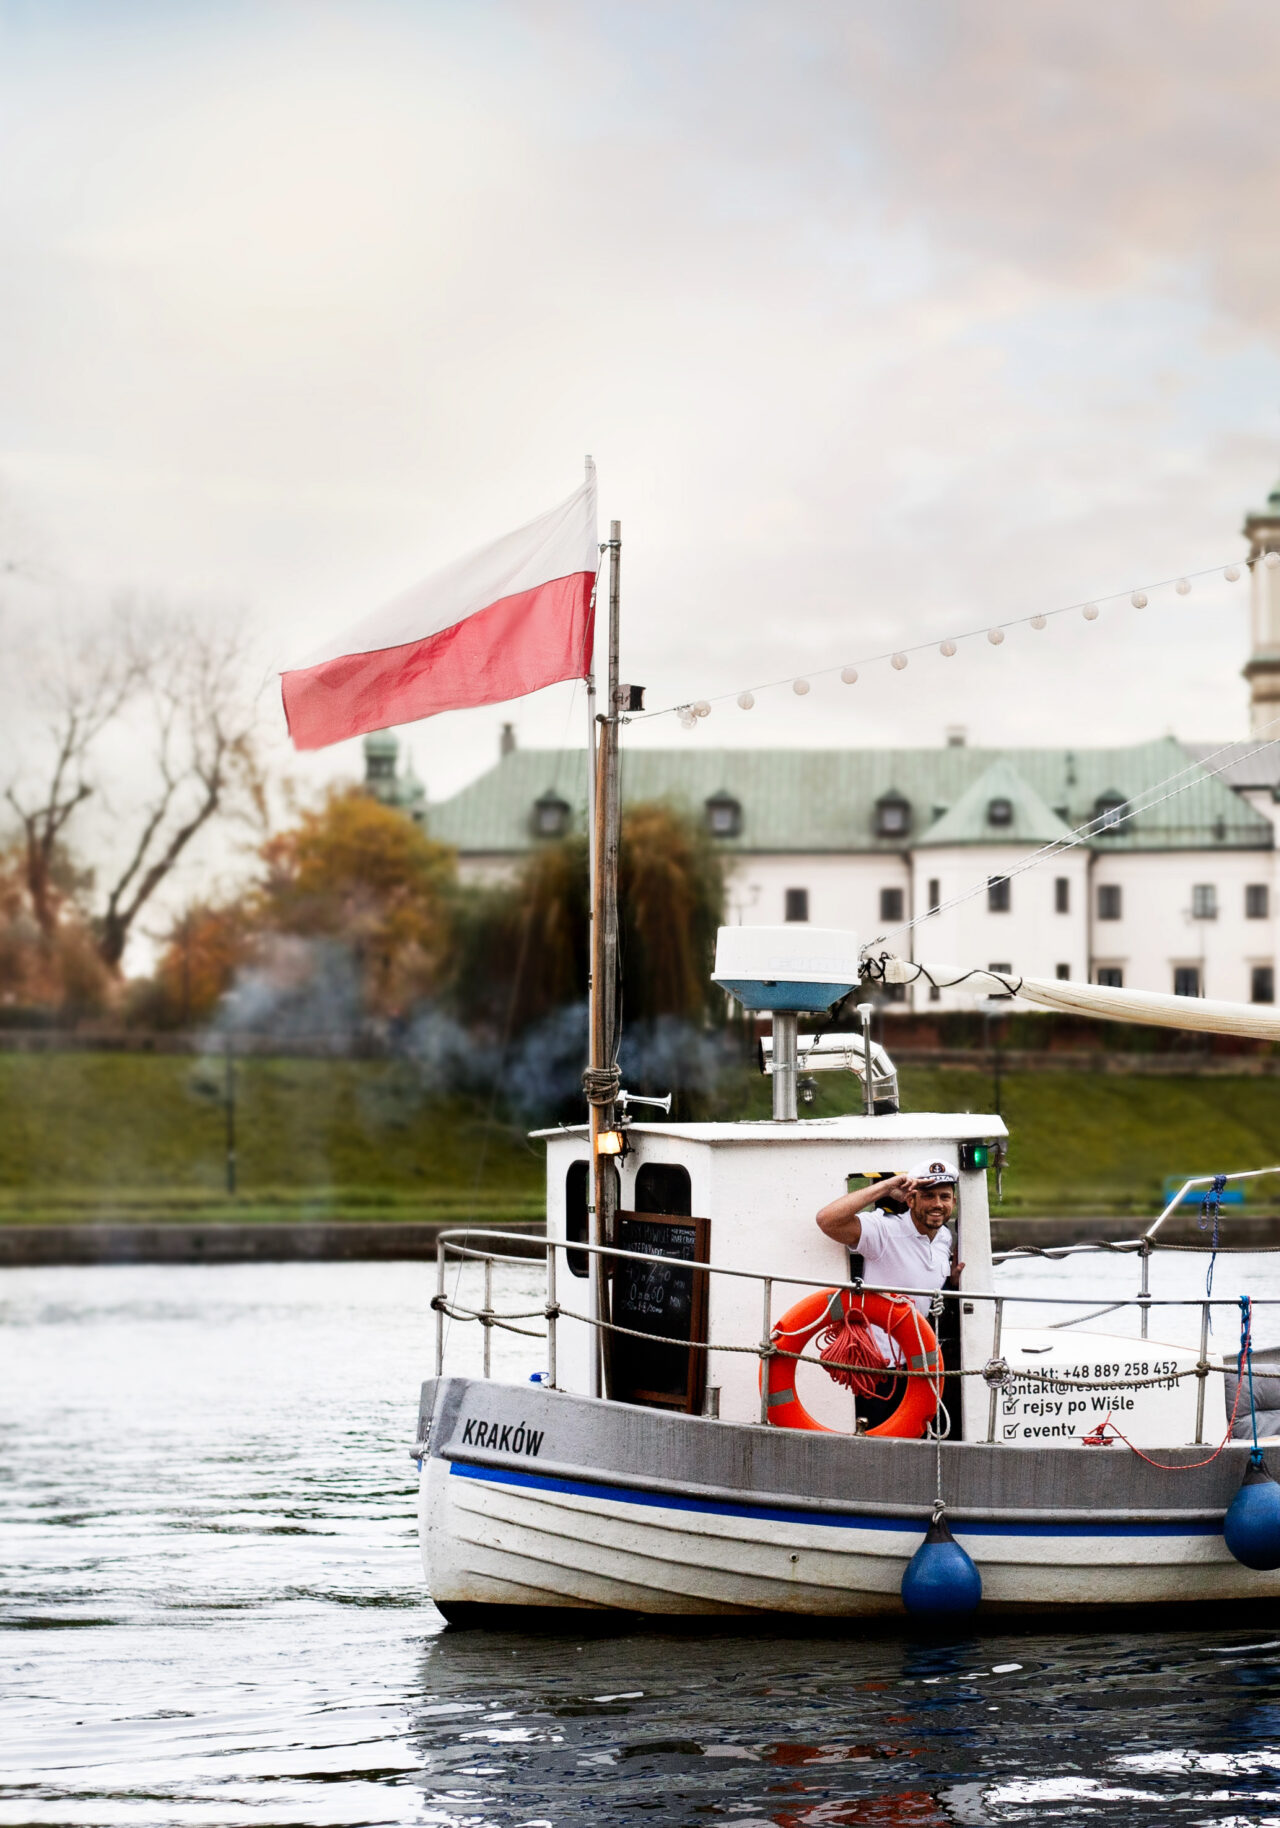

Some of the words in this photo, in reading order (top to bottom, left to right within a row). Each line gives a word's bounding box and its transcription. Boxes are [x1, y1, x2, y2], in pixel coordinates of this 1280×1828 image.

[1001, 1367, 1059, 1382] ontakt:
[1064, 1364, 1090, 1379] +48
[1094, 1363, 1120, 1378] 889
[1124, 1362, 1149, 1377] 258
[1153, 1361, 1178, 1375] 452
[1023, 1399, 1063, 1416] rejsy
[1068, 1401, 1087, 1415] po
[1091, 1396, 1135, 1411] Wiśle
[462, 1418, 544, 1456] KRAKÓW
